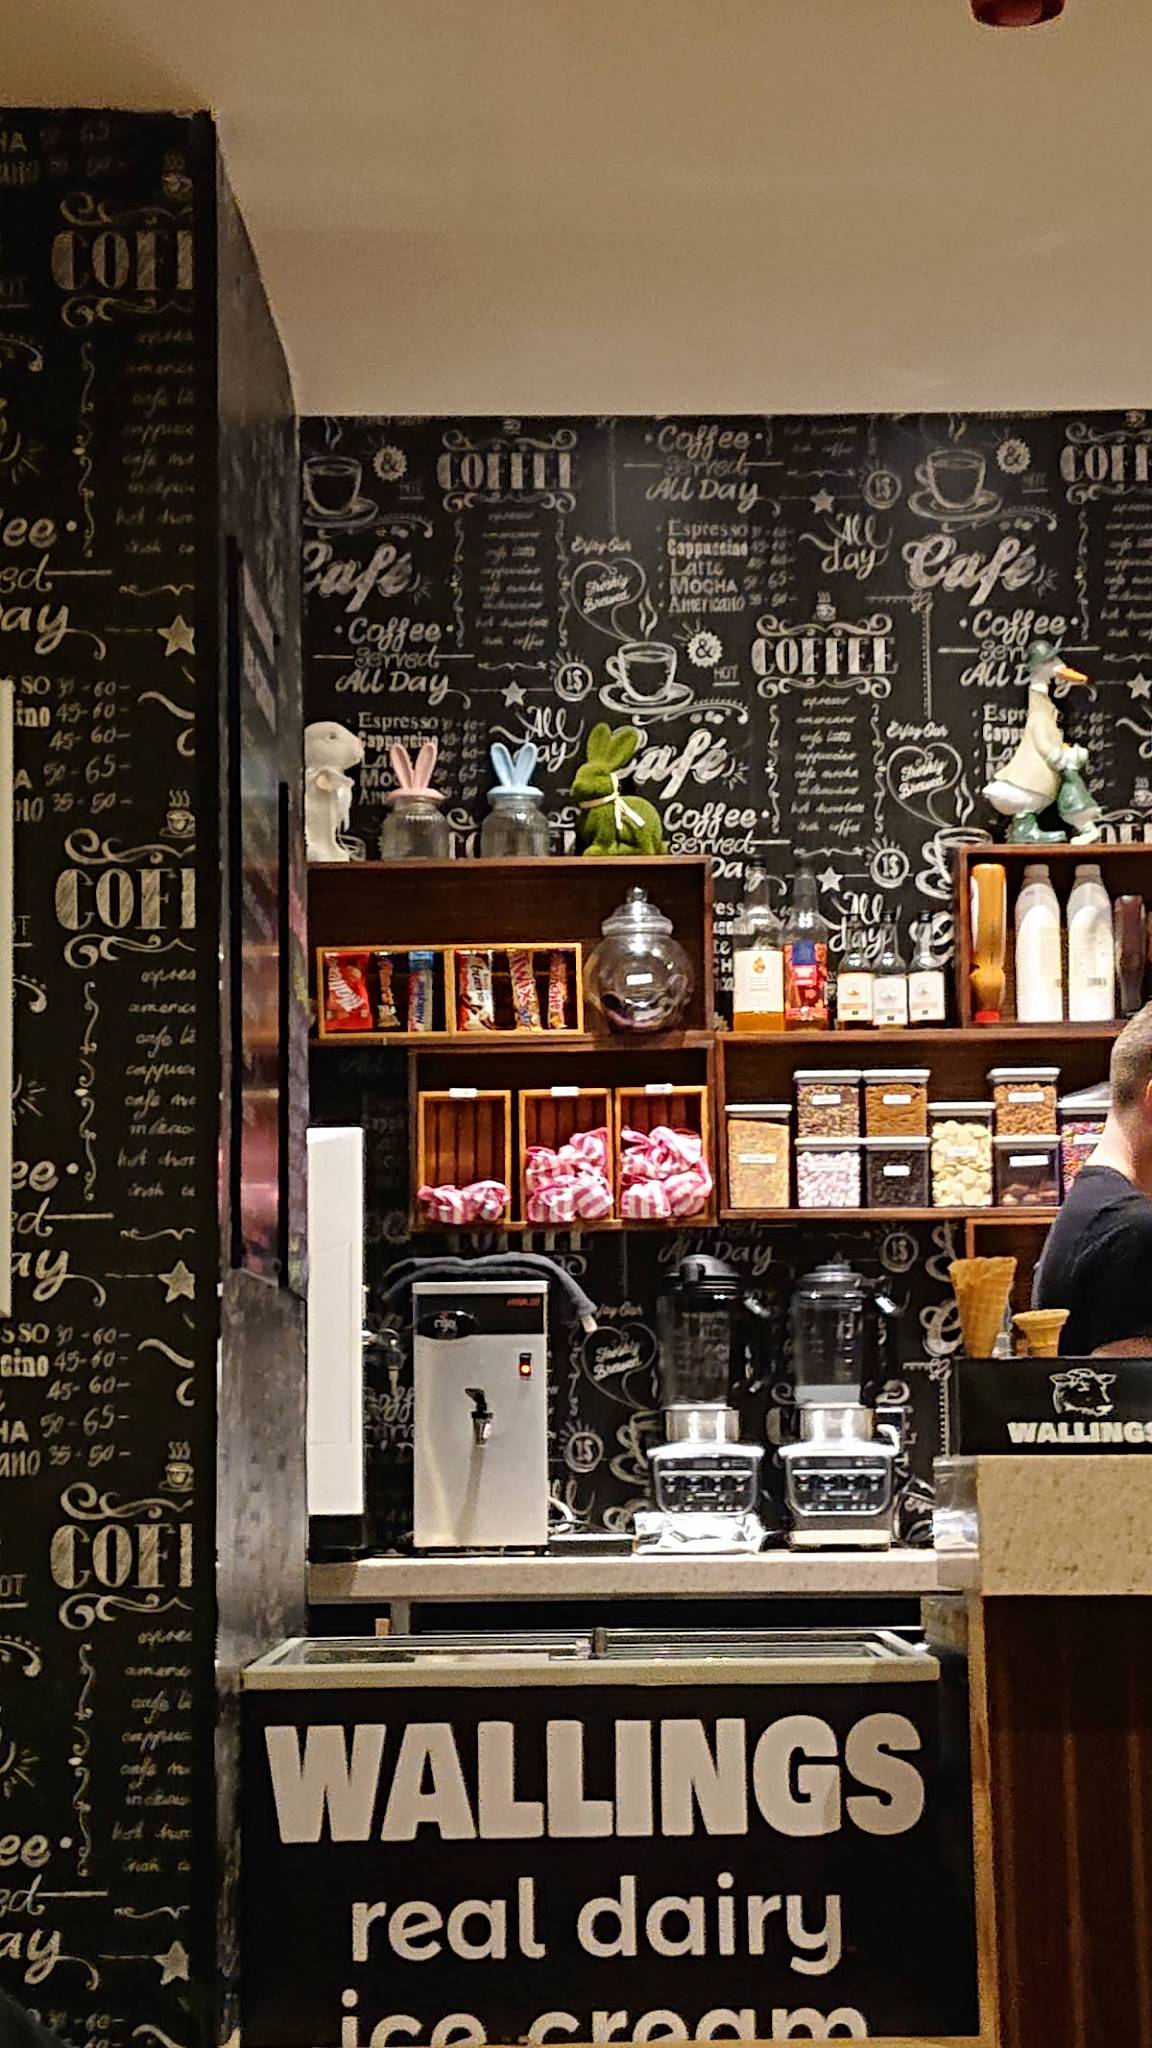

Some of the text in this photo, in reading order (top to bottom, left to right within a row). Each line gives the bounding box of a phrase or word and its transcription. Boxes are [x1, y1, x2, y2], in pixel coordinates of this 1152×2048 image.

[657, 425, 749, 459] Coffee
[646, 477, 759, 514] All Day
[668, 519, 748, 540] Espresso
[670, 576, 739, 595] MOCHA
[902, 533, 1037, 606] Café
[668, 595, 746, 613] Americano
[347, 617, 442, 652] Coffee
[972, 608, 1068, 646] Coffee
[752, 637, 899, 675] COFFEE
[335, 670, 450, 706] All Day
[961, 661, 1010, 688] All
[358, 712, 438, 733] Espresso
[620, 729, 728, 800] afé
[664, 802, 758, 839] Coffee
[671, 830, 757, 855] Served
[264, 1712, 926, 1844] WALLINGS
[352, 1872, 843, 1976] real dairy
